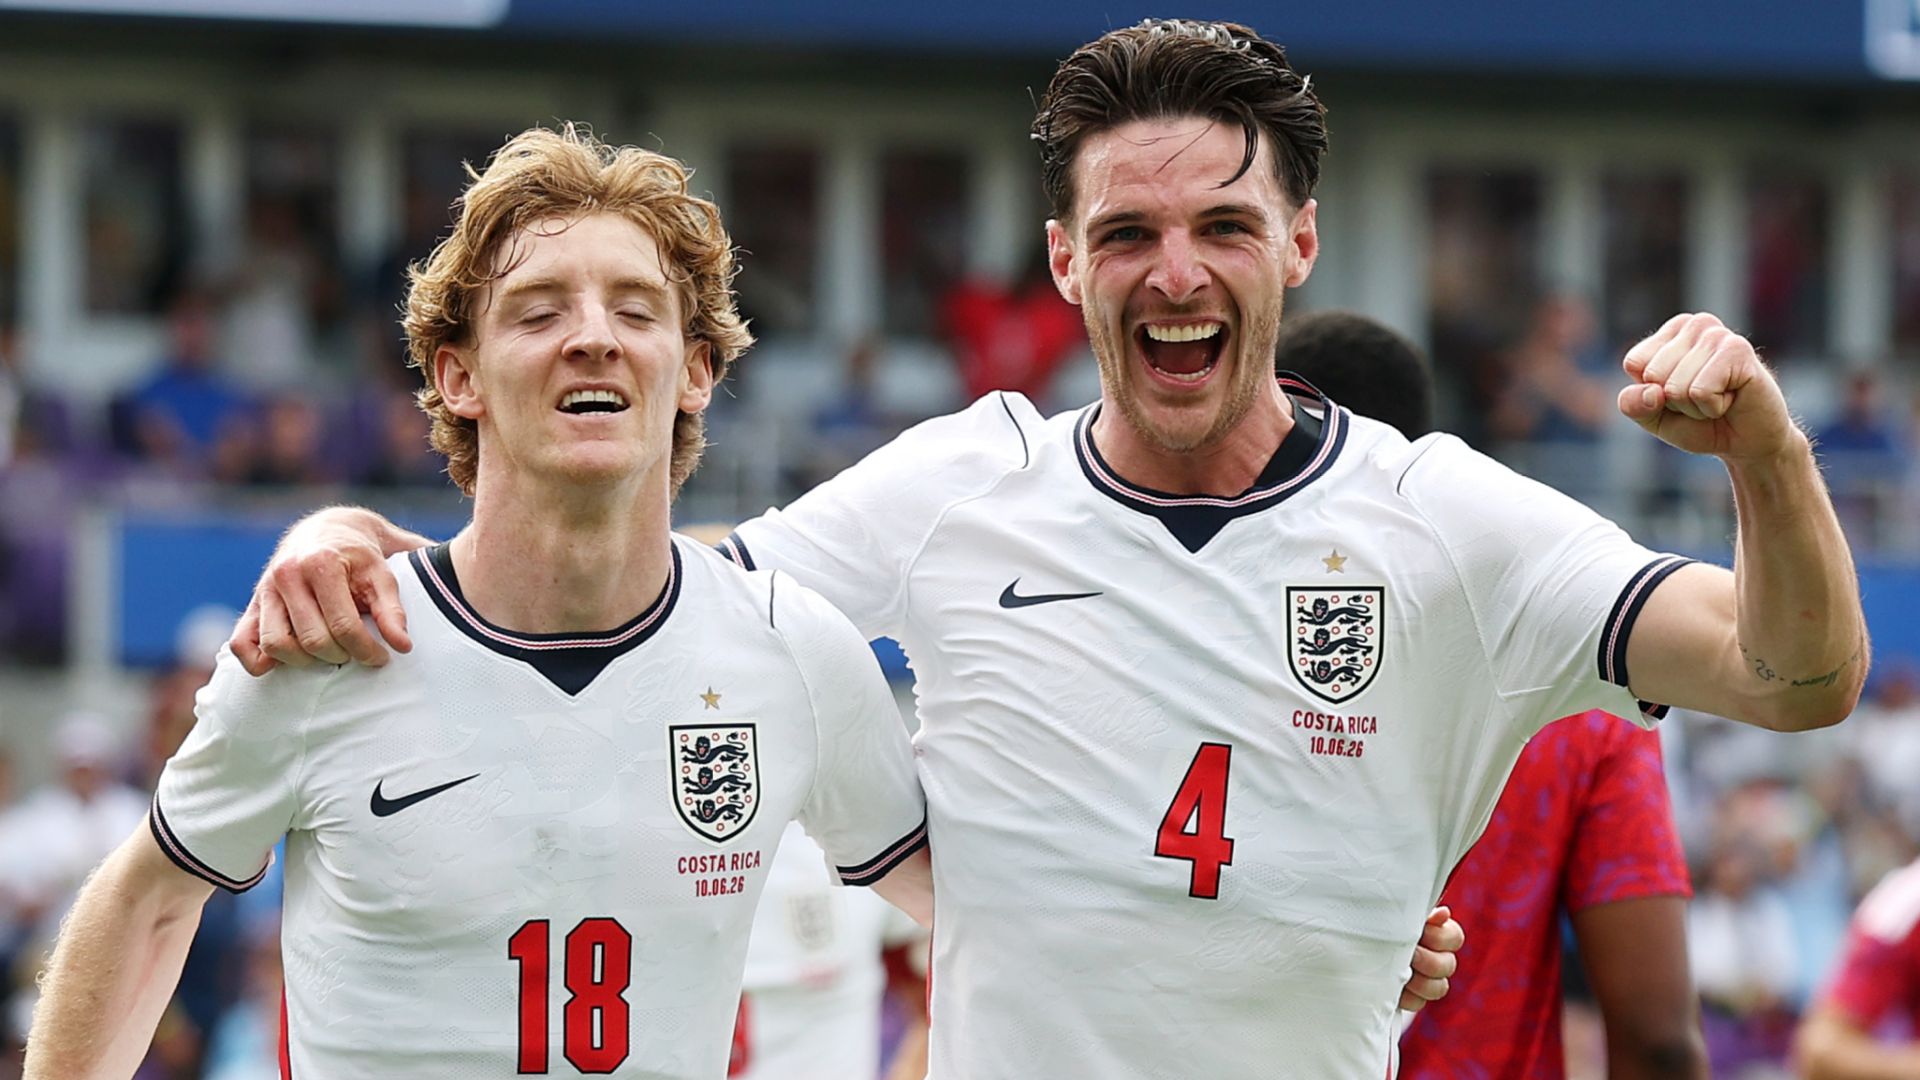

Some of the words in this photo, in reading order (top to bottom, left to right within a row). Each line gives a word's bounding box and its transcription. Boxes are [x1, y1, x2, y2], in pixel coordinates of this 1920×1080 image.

[1292, 710, 1344, 733] COSTA
[1348, 716, 1377, 734] RICA
[1310, 736, 1364, 758] 10.06.26
[1155, 742, 1234, 899] 4
[677, 854, 726, 874] COSTA
[730, 850, 760, 871] RICA
[695, 876, 745, 897] 10.06.26
[508, 917, 632, 1075] 18
